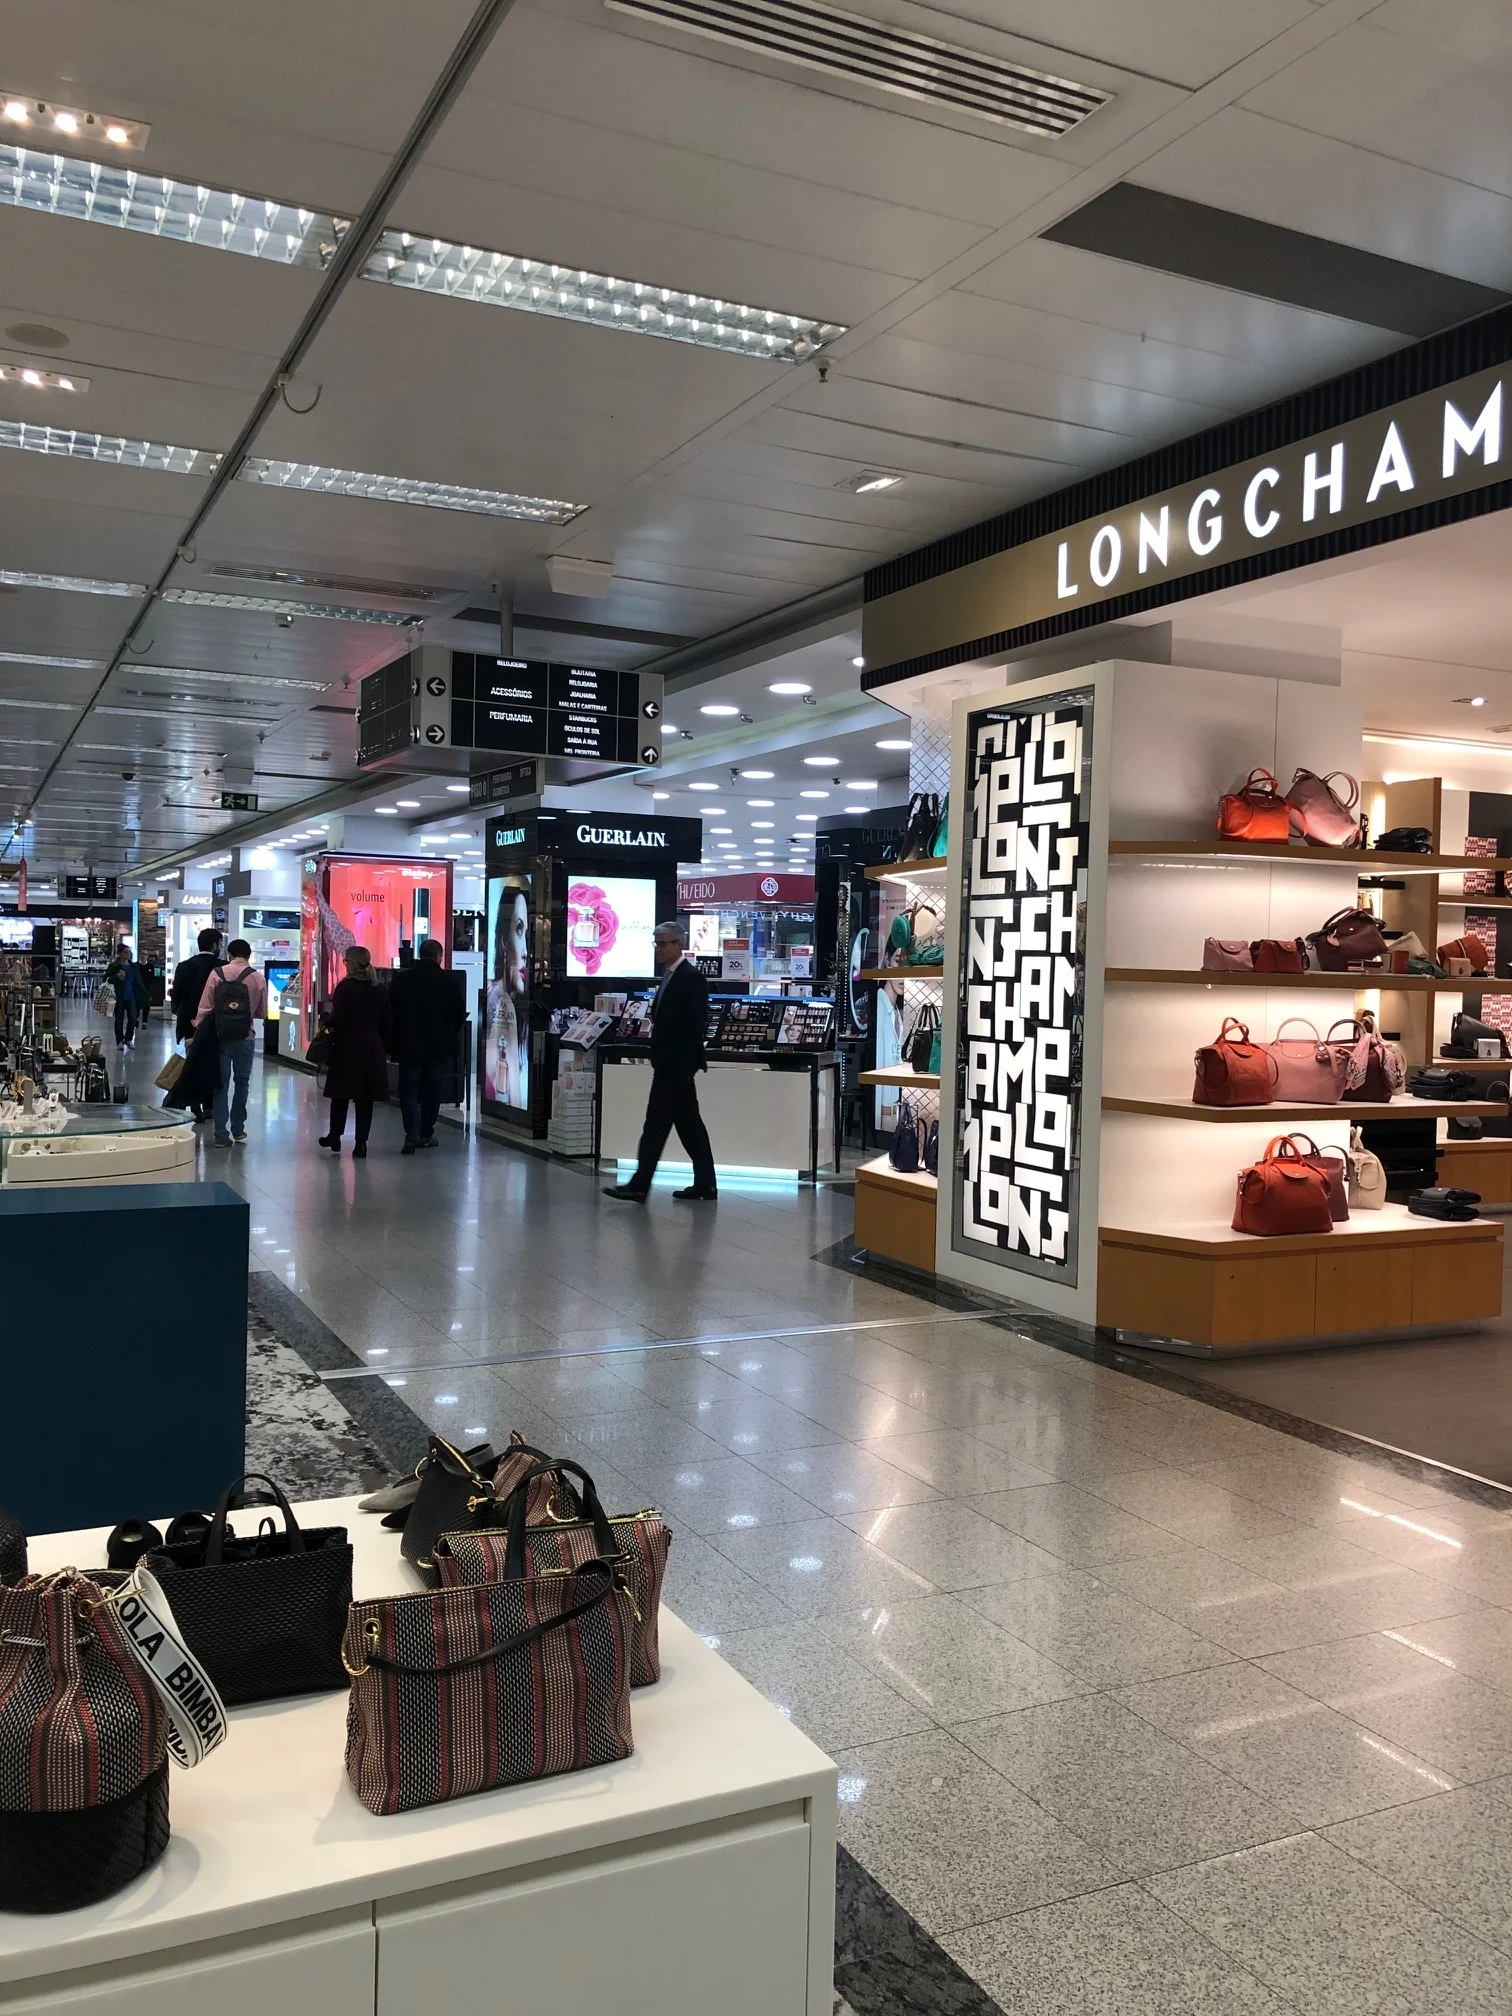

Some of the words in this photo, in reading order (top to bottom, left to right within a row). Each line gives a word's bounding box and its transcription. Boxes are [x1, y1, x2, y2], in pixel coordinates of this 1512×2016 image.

[490, 686, 533, 699] ACESSÓRIOS
[558, 700, 577, 708] MALAS
[580, 703, 608, 712] CARTEIRAS
[489, 710, 534, 724] PERFUMARIA
[568, 714, 598, 724] STARBUCKS
[590, 727, 601, 735] SOL
[495, 827, 526, 847] GUERLAIN
[576, 824, 667, 848] GUERLAIN
[181, 894, 212, 905] LANC
[350, 889, 386, 903] volume
[164, 1661, 223, 1749] BIMBA
